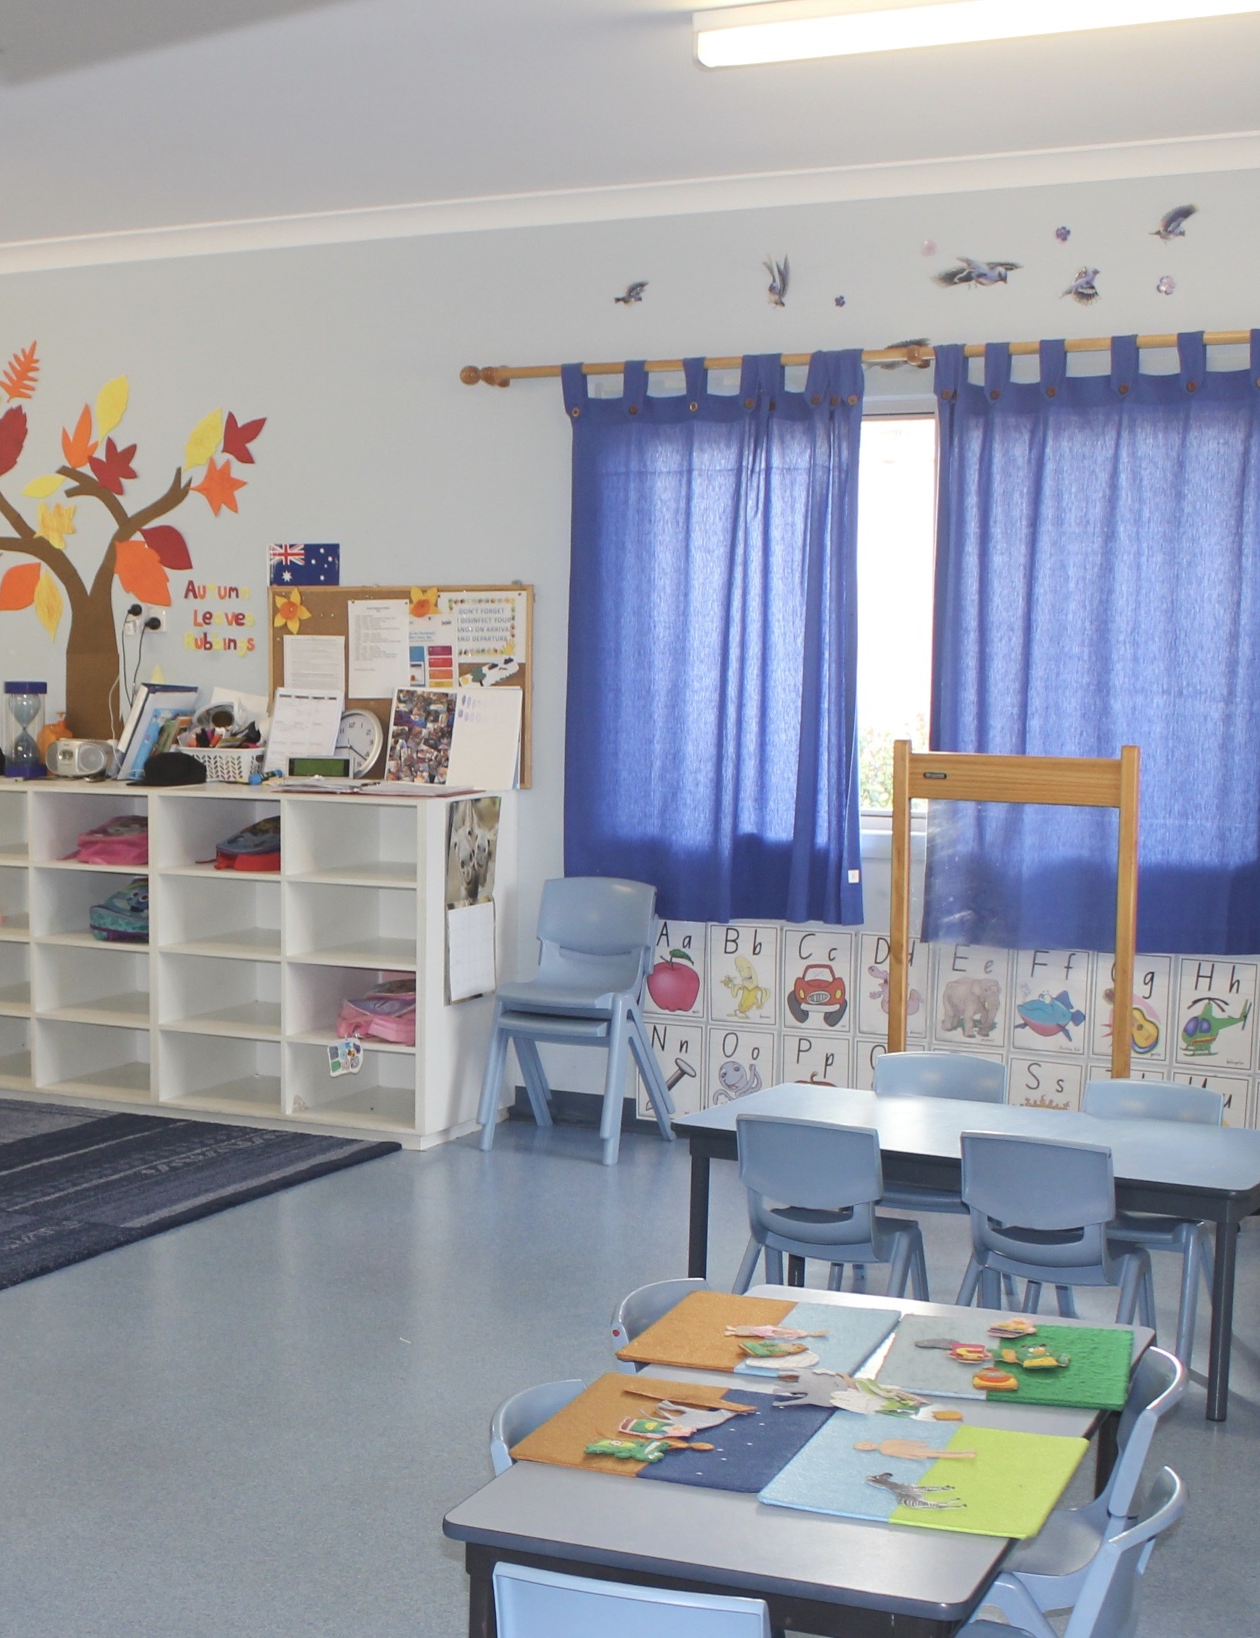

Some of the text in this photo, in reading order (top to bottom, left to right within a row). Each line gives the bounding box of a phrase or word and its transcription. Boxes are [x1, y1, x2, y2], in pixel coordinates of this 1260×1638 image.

[184, 580, 251, 600] Autumn
[194, 609, 255, 628] Leaves
[184, 631, 256, 657] Rubbings
